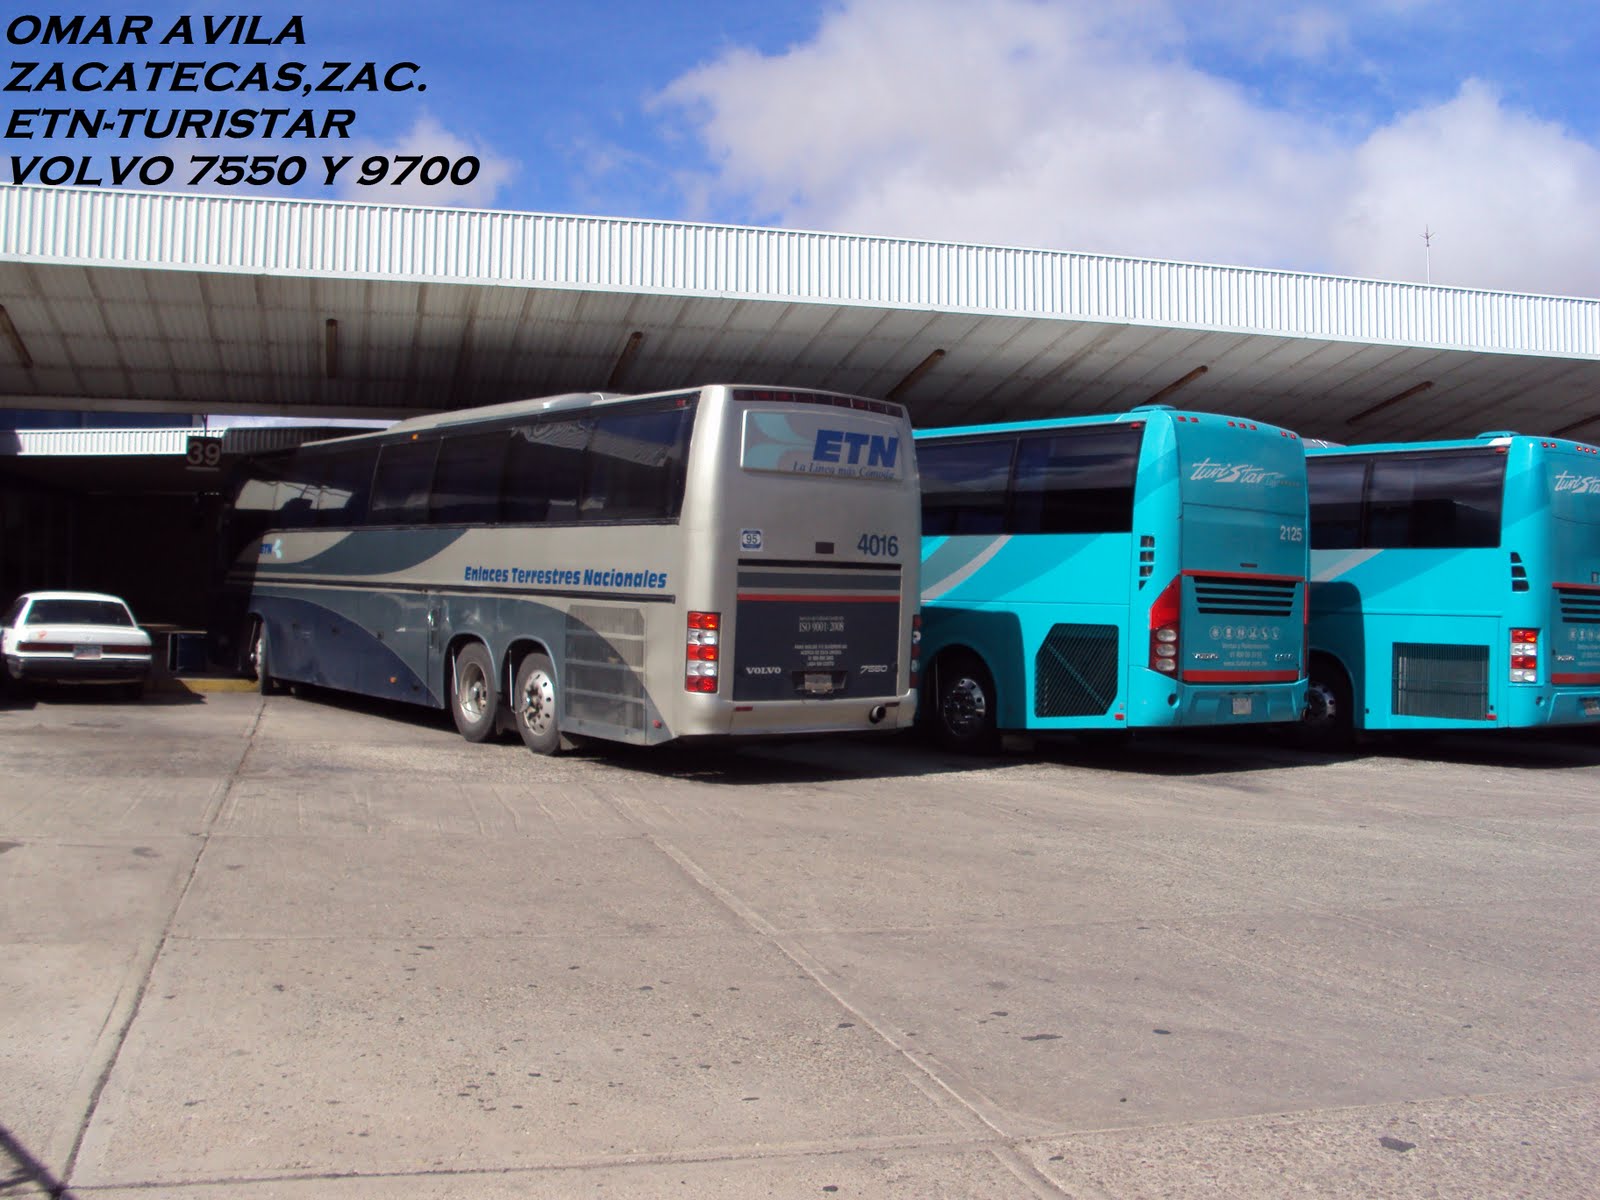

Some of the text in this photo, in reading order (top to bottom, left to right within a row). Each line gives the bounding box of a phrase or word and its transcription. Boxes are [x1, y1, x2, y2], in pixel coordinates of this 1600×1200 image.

[187, 441, 221, 466] 39
[813, 429, 899, 468] ETN
[746, 534, 758, 544] 95
[857, 533, 899, 557] 4016
[1280, 525, 1303, 541] 2125
[464, 565, 667, 589] Enlaces Terrestres Nacionales
[746, 666, 782, 675] VOLVO
